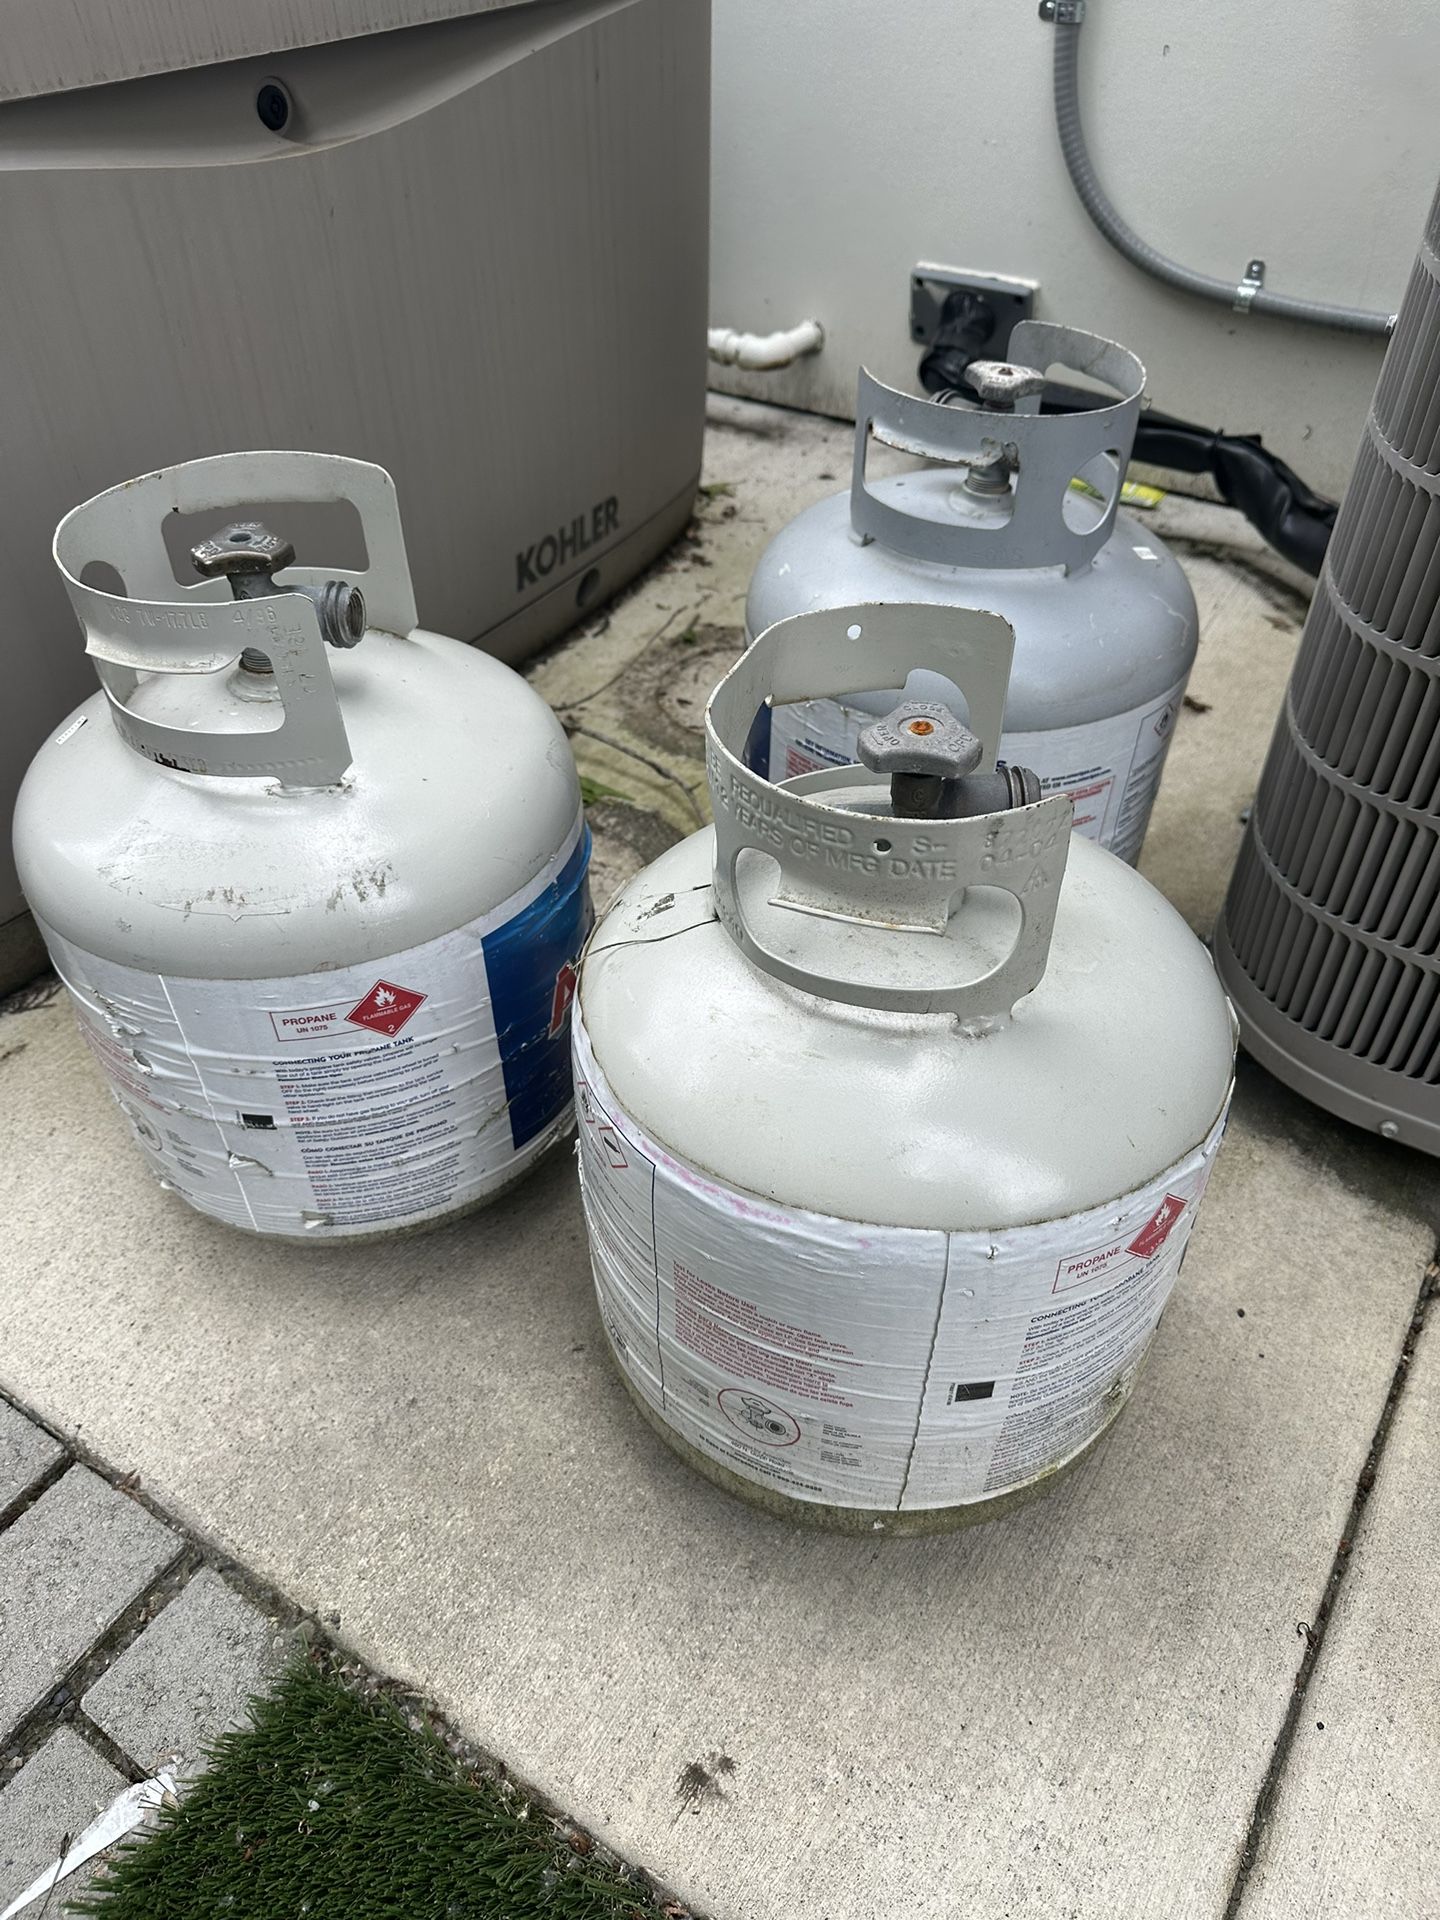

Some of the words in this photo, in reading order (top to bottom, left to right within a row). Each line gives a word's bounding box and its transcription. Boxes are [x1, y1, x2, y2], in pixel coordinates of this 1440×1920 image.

[516, 496, 619, 592] KOHLER
[789, 836, 822, 862] OF
[889, 858, 958, 881] DATE
[282, 1012, 338, 1027] PROPANE
[362, 1008, 399, 1022] FLAMMABLE
[399, 1002, 412, 1012] GAS
[296, 1025, 309, 1034] UN
[387, 1024, 396, 1033] 2
[273, 1057, 327, 1065] CONNECTING
[329, 1053, 352, 1061] YOUR
[393, 1036, 415, 1048] TANK
[1067, 1244, 1121, 1275] PROPANE
